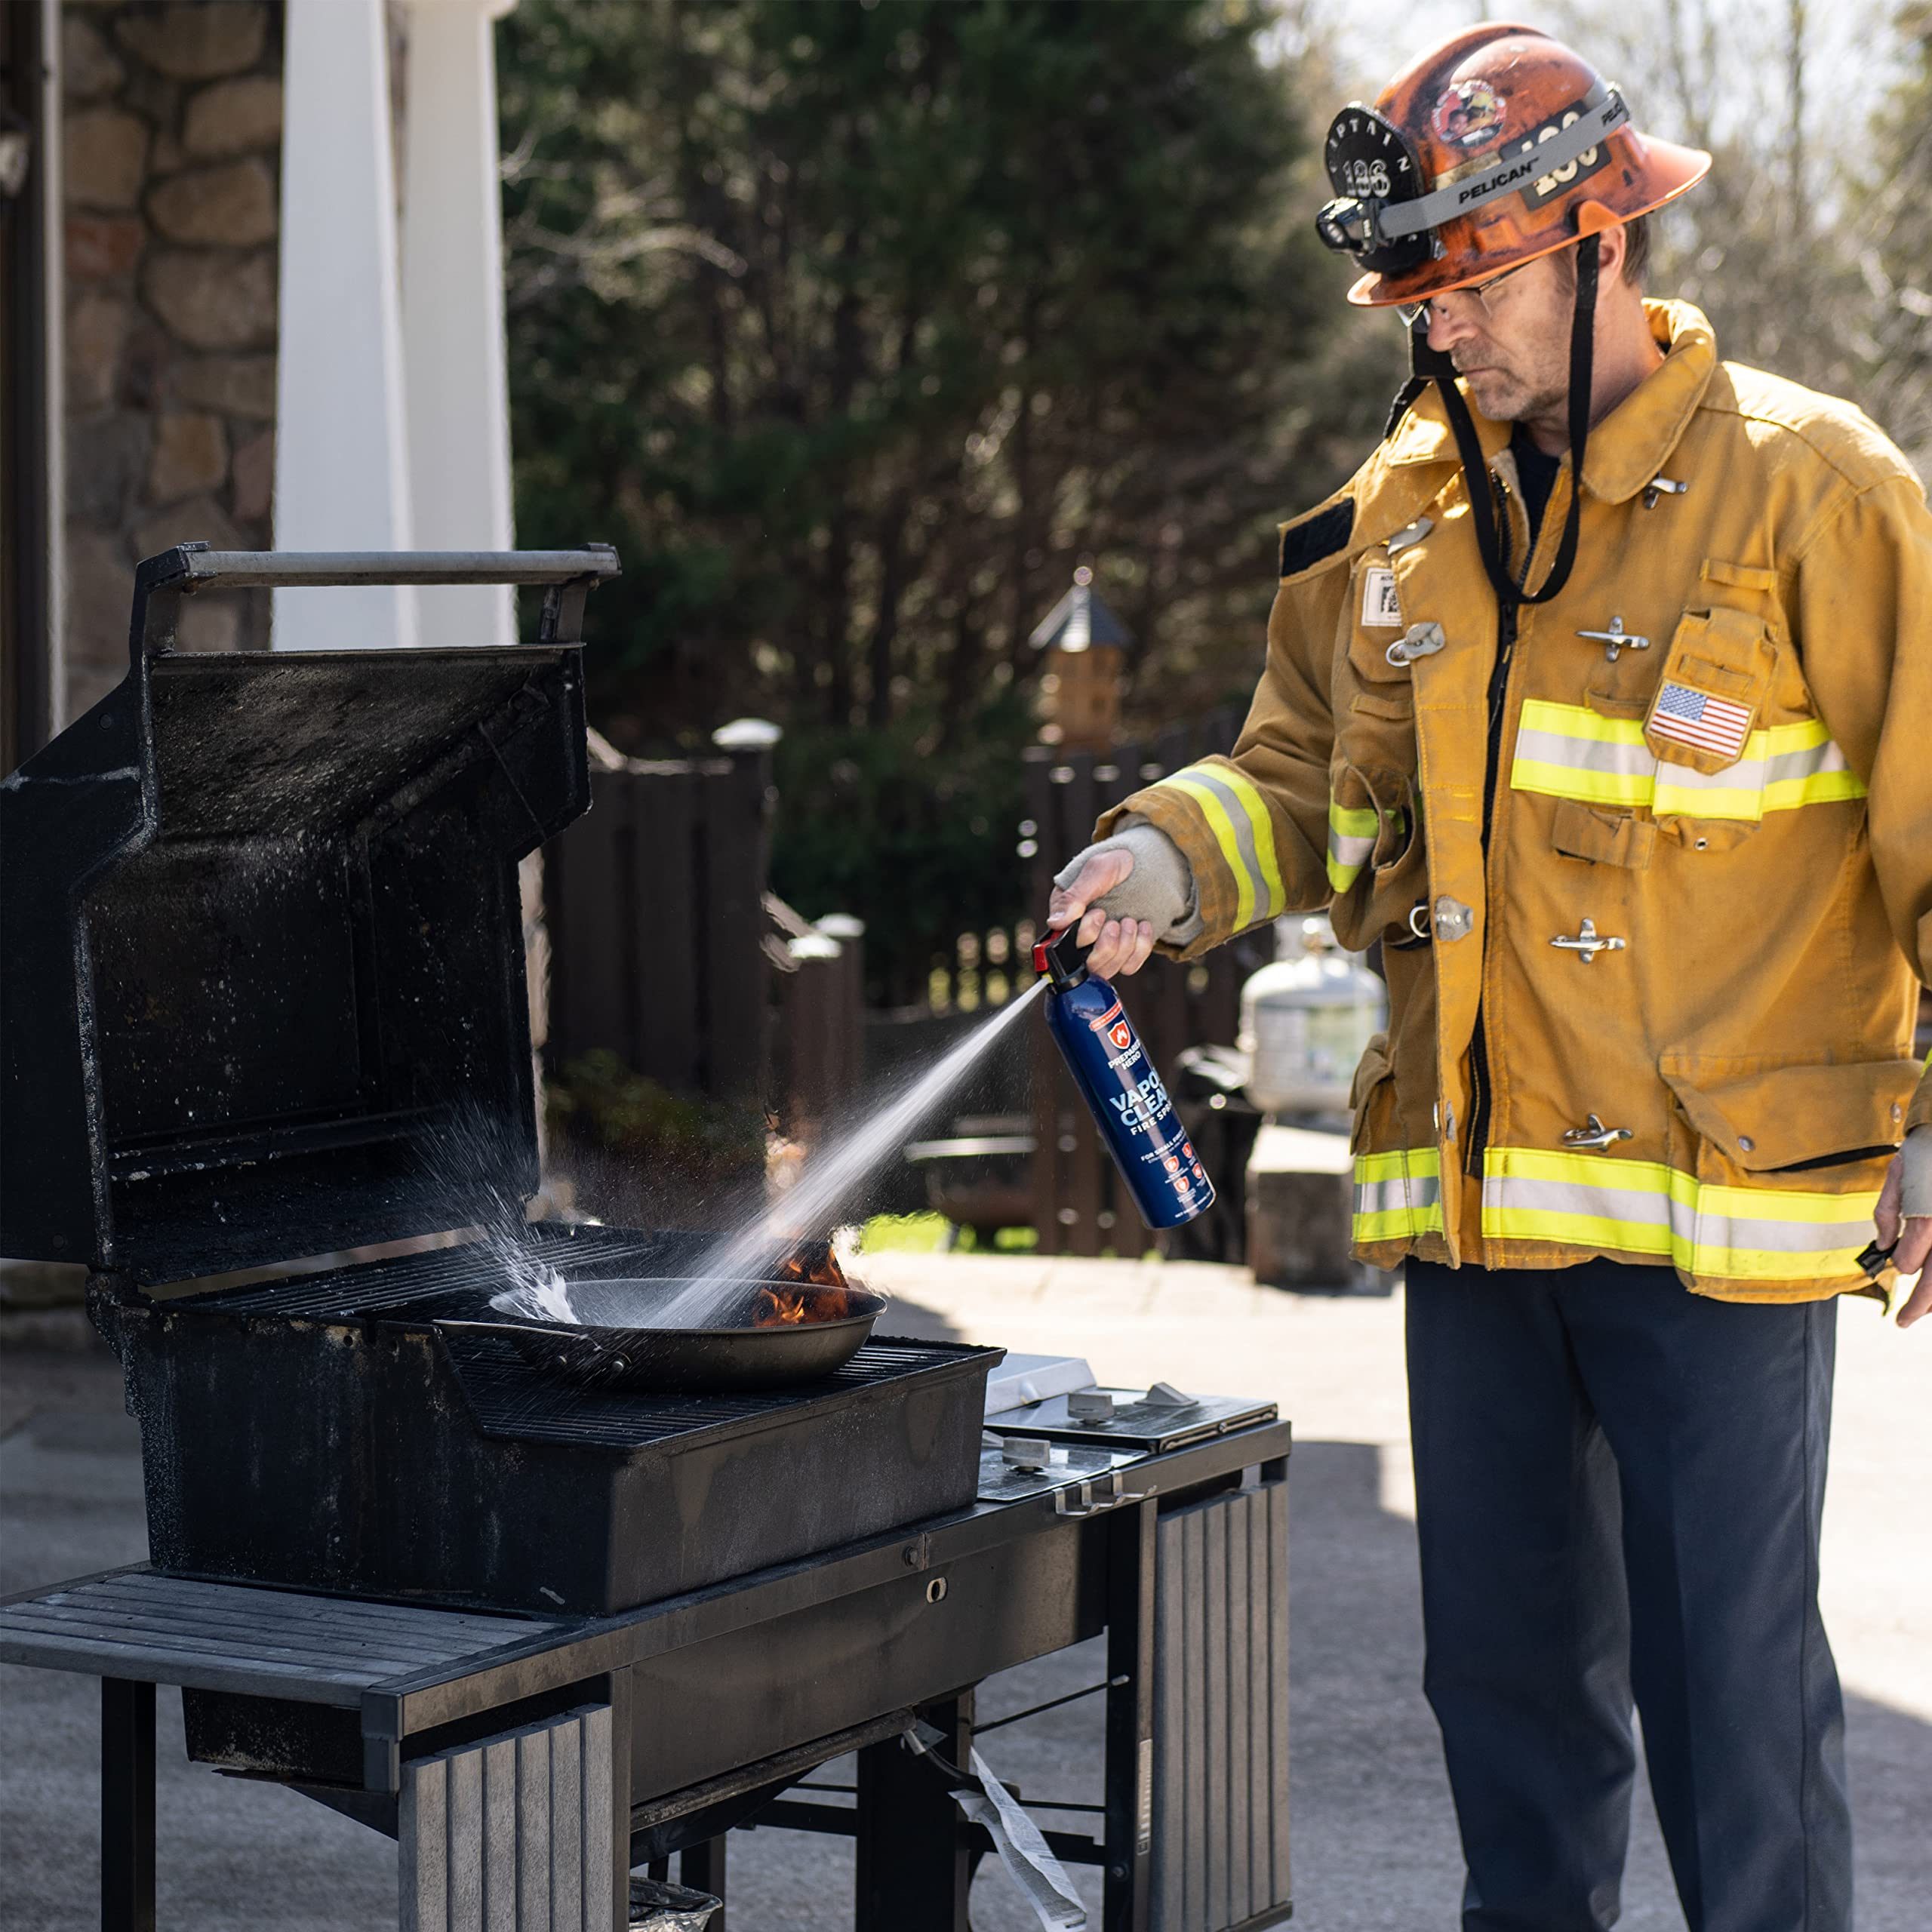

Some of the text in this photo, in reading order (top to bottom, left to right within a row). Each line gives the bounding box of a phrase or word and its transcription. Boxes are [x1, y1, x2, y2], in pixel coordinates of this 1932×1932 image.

[1343, 158, 1391, 198] 186
[1121, 1051, 1141, 1069] HERO
[1109, 1068, 1161, 1112] VAPO
[1130, 1117, 1157, 1136] FIRE
[1140, 1152, 1155, 1161] FOR
